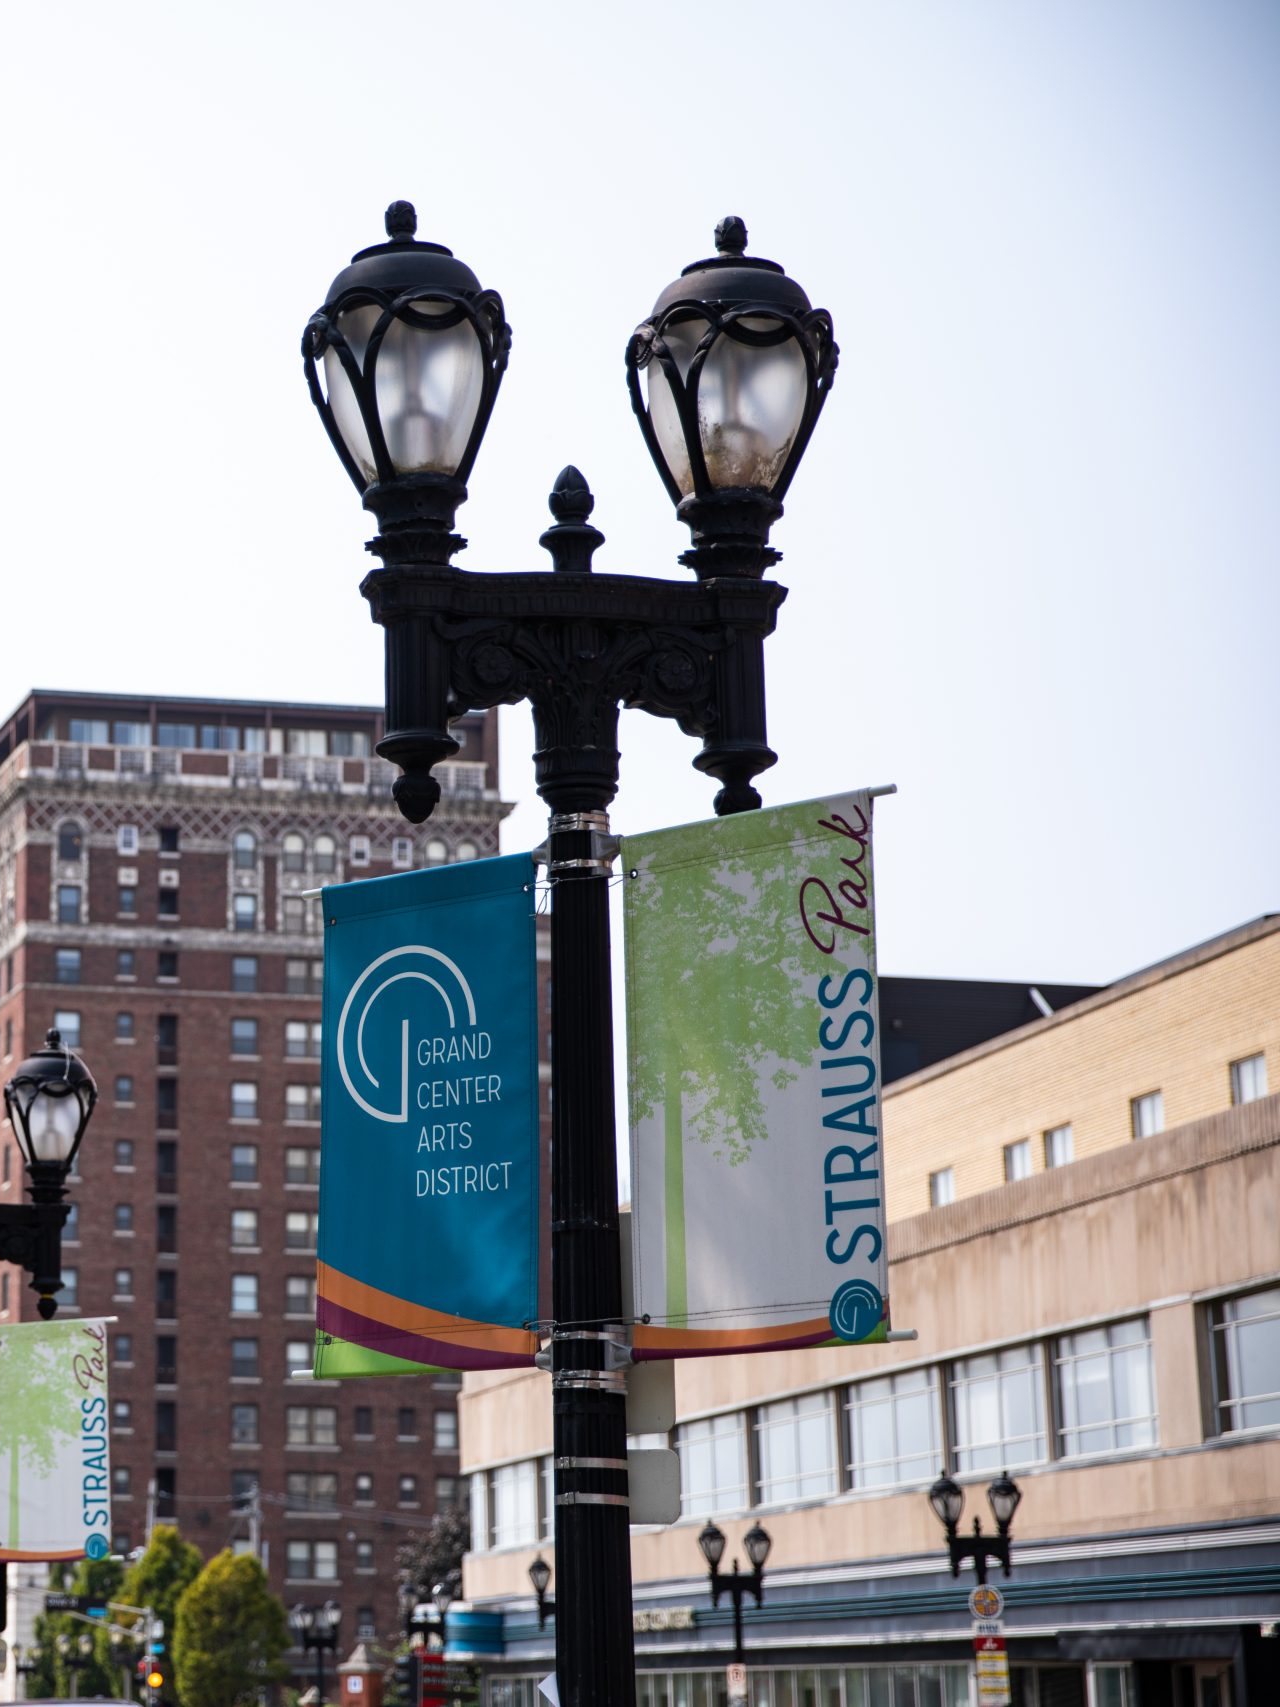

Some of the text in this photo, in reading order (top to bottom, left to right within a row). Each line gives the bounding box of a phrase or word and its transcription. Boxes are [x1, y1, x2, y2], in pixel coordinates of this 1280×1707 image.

[416, 1031, 492, 1066] GRAND
[799, 804, 883, 1265] STRAUSS Park
[416, 1074, 502, 1110] CENTER
[416, 1121, 473, 1154] ARTS
[416, 1161, 513, 1198] DISTRICT
[73, 1324, 108, 1527] STRAUSS Park
